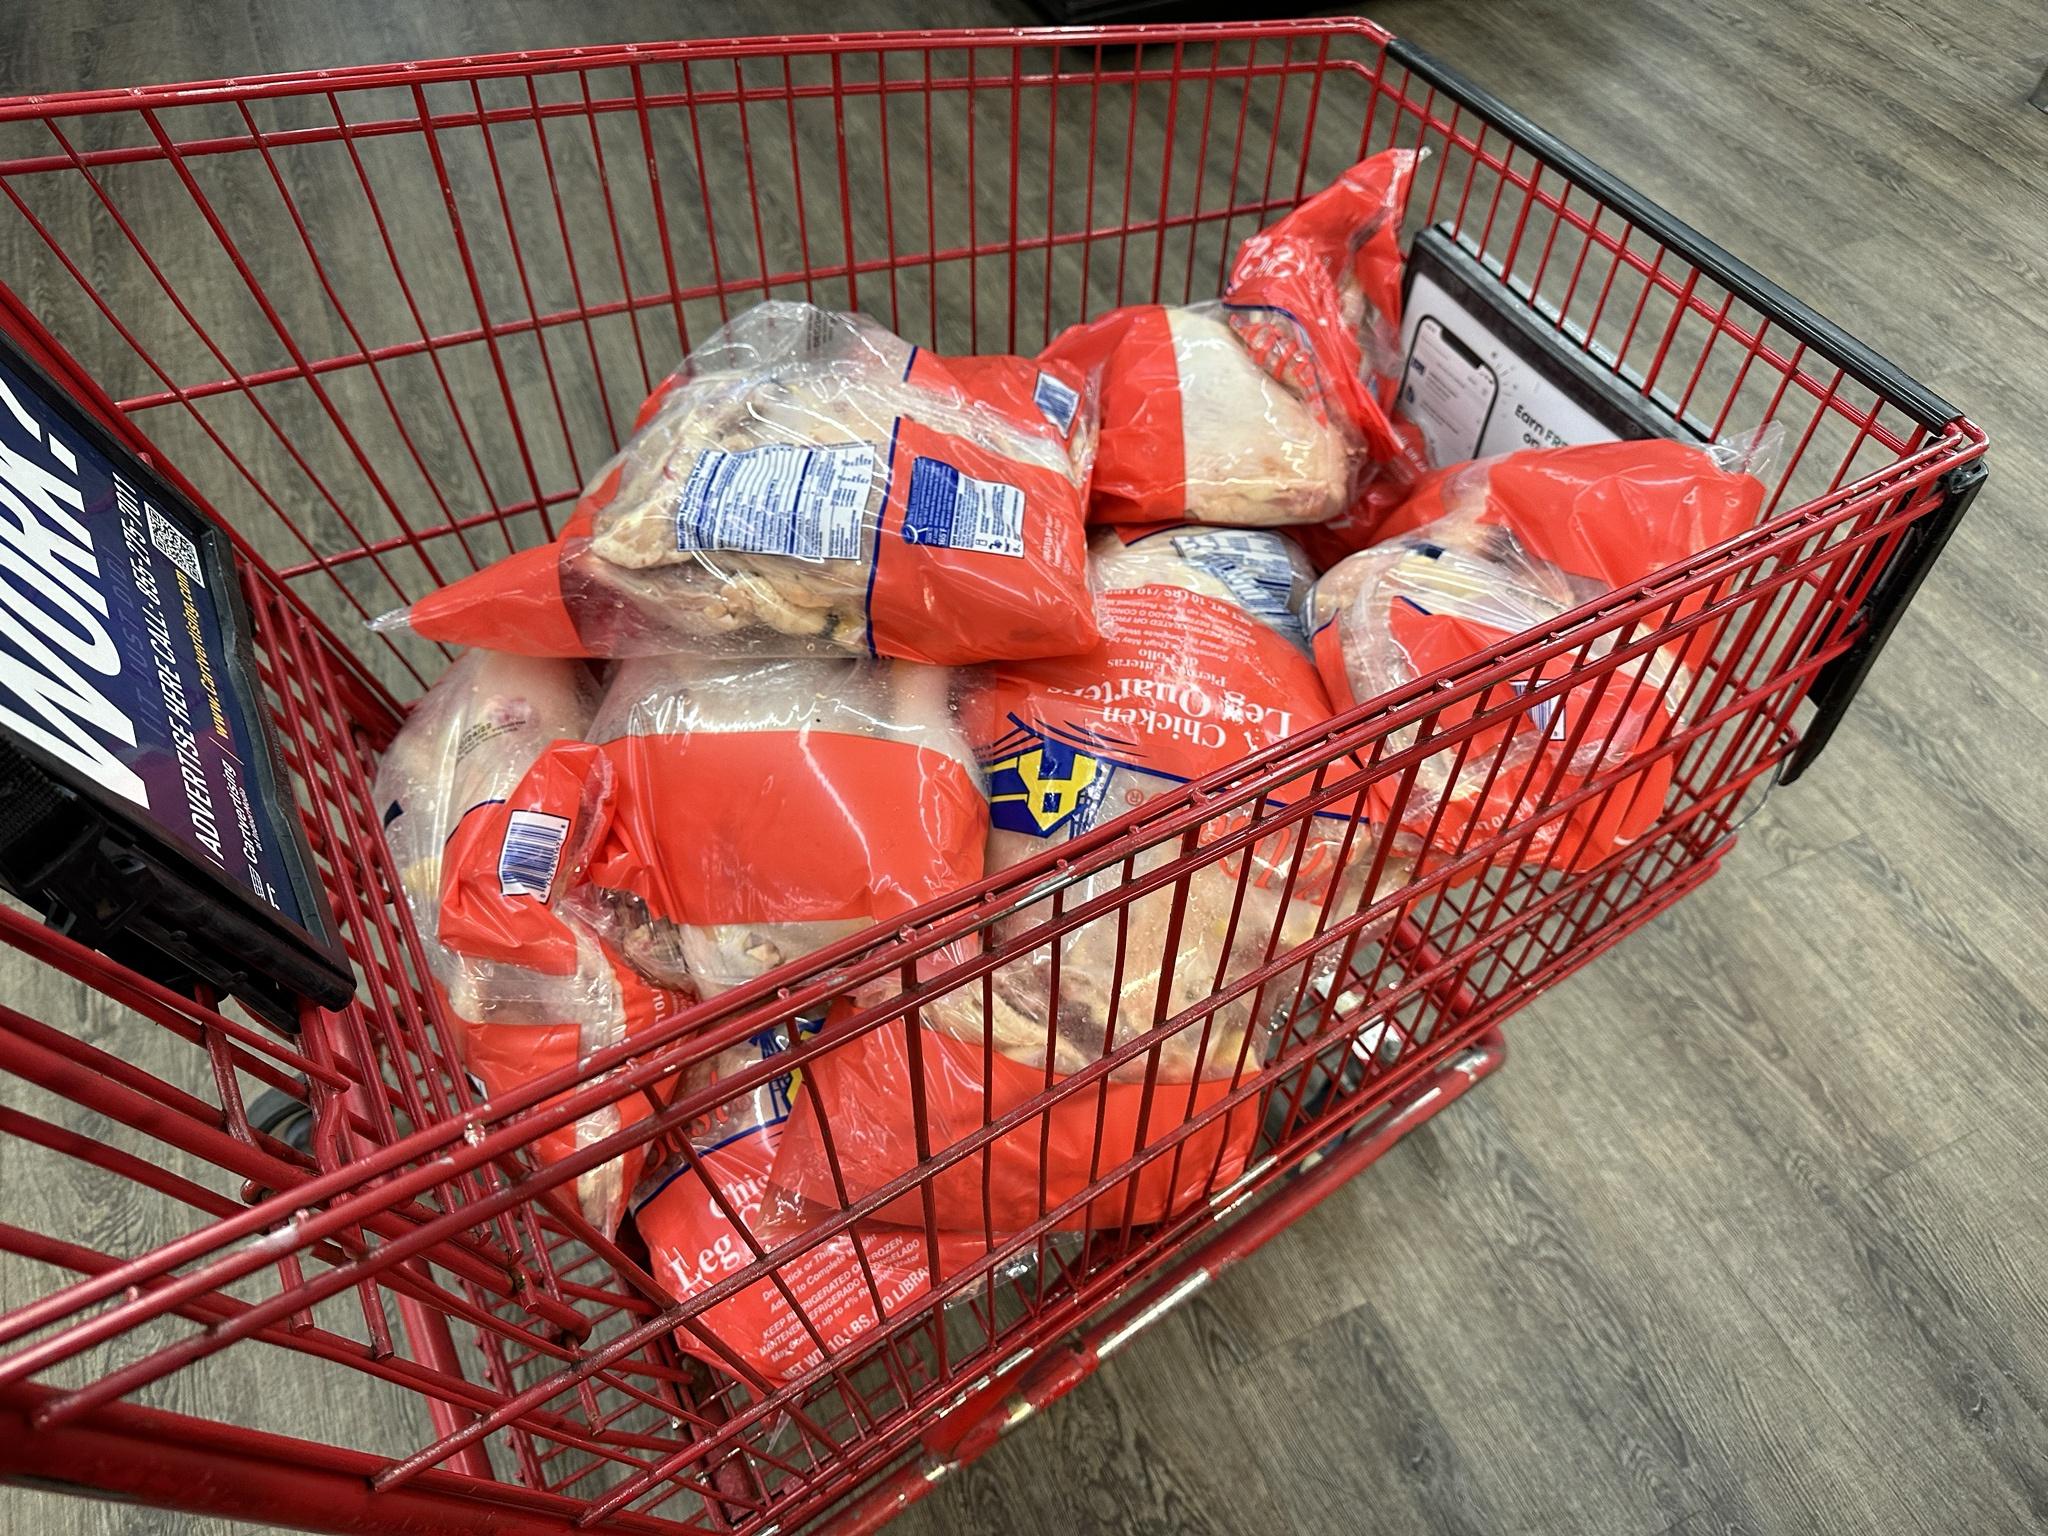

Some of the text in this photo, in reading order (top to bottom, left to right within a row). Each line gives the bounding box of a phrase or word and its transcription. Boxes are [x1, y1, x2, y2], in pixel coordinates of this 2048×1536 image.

[1515, 404, 1544, 436] Earn
[112, 472, 224, 860] ADVERTISE HERE CALL: 855-275-7011
[1136, 647, 1176, 664] Pollo
[175, 568, 258, 864] Cartvertising www.Cartvertising.com
[1047, 678, 1211, 718] Quarters
[1103, 707, 1226, 748] Chicken
[668, 1233, 741, 1294] Leg
[762, 1267, 804, 1302] Drustick
[803, 1260, 813, 1271] or
[796, 1283, 807, 1293] to
[806, 1254, 845, 1286] Complete
[891, 1266, 930, 1303] LIBRA
[762, 1317, 786, 1340] KEEP
[822, 1314, 834, 1326] up
[833, 1306, 844, 1317] to
[844, 1296, 859, 1309] 4%
